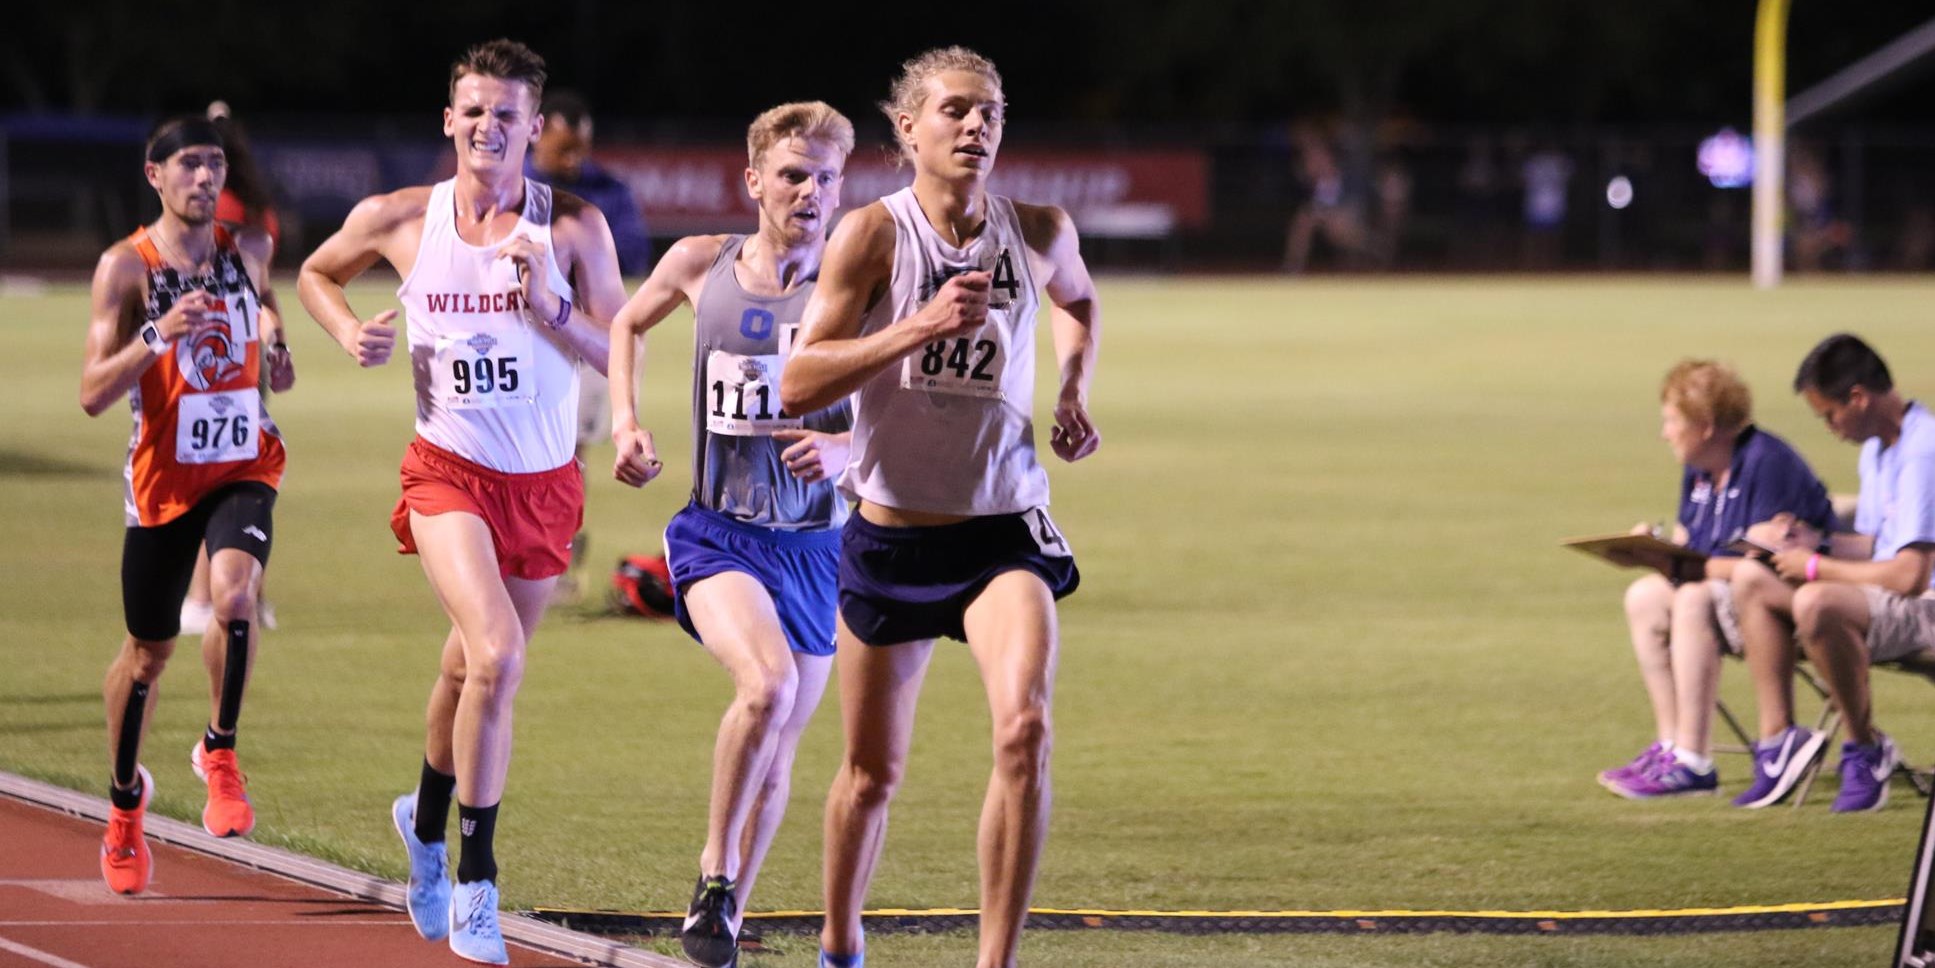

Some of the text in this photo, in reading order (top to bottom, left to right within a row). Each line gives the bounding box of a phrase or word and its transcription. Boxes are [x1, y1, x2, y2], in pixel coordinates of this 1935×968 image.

[992, 248, 1020, 299] 4
[235, 297, 251, 338] 1
[452, 356, 519, 394] 995
[920, 337, 997, 381] 842
[712, 380, 800, 420] 111
[191, 414, 249, 450] 976
[1036, 508, 1066, 552] 4
